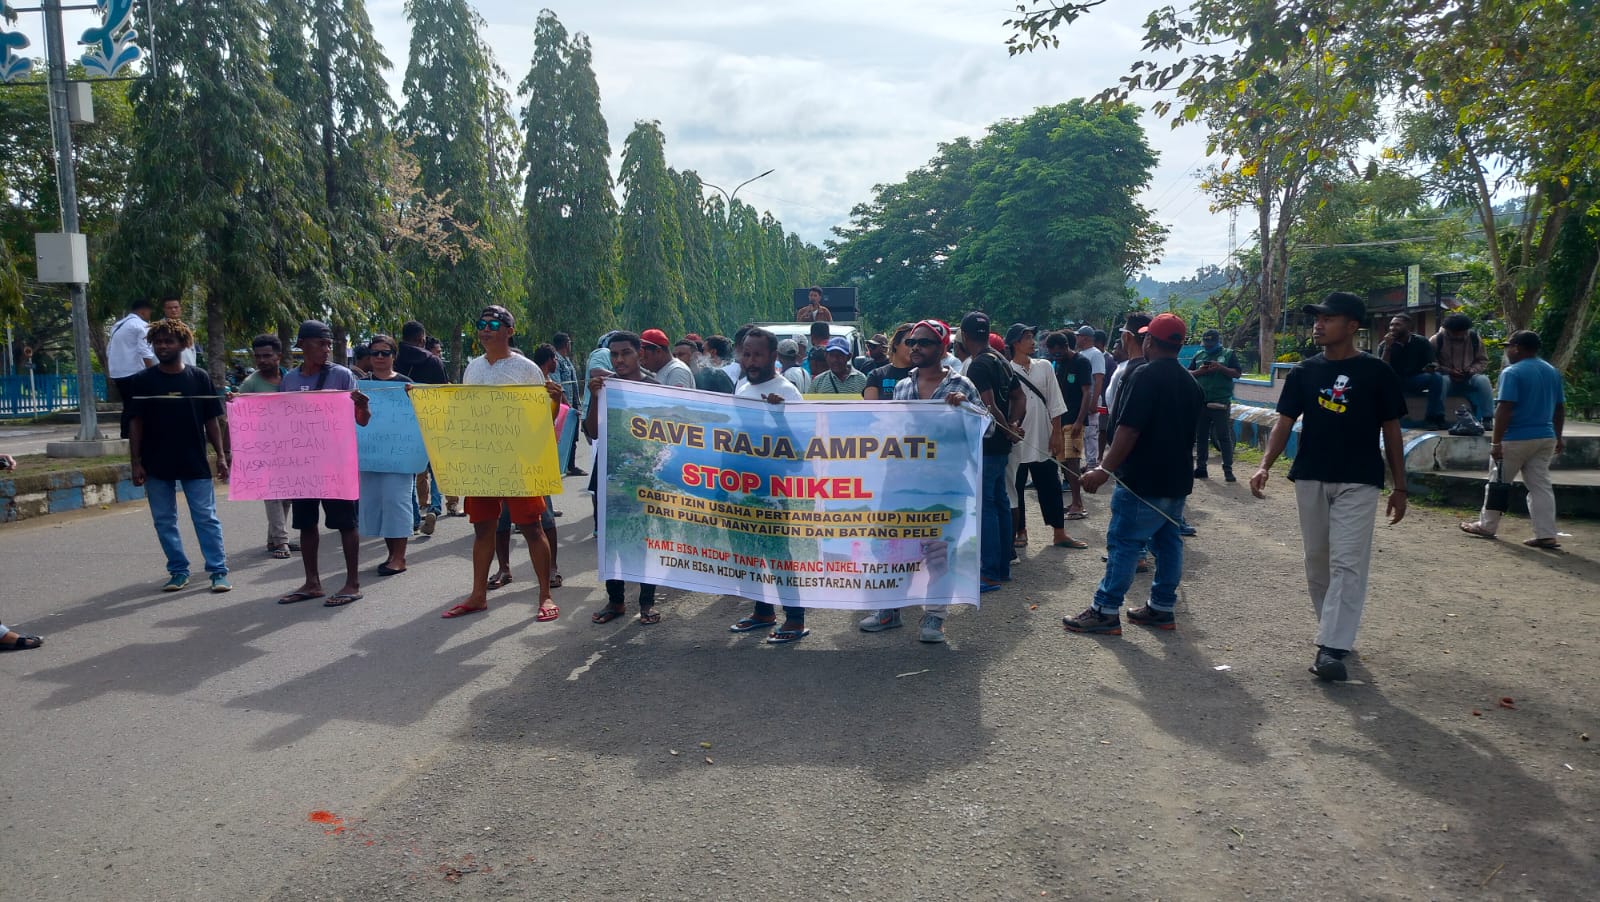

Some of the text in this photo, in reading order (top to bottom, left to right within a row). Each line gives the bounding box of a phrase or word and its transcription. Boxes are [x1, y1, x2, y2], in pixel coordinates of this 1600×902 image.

[444, 390, 480, 402] TOLAK
[630, 416, 937, 460] SAVE RAJA AMPAT:
[682, 463, 873, 499] STOP NIKEL
[638, 489, 949, 525] CABUT IZIN USAHA PERTAMBAGAN (IUP) NIKEL
[647, 504, 938, 538] DARI PULAU MANYAIFUN DAN BATANG PELE
[645, 537, 674, 552] "KAMI
[677, 542, 699, 557] BISA
[701, 548, 731, 562] HIDUP
[733, 553, 767, 569] TANPA
[770, 559, 823, 573] TAMBANG
[891, 561, 921, 574] KAMI
[659, 556, 904, 590] TIDAK BISA HIDUP TANPA KELESTARIAN ALAM."
